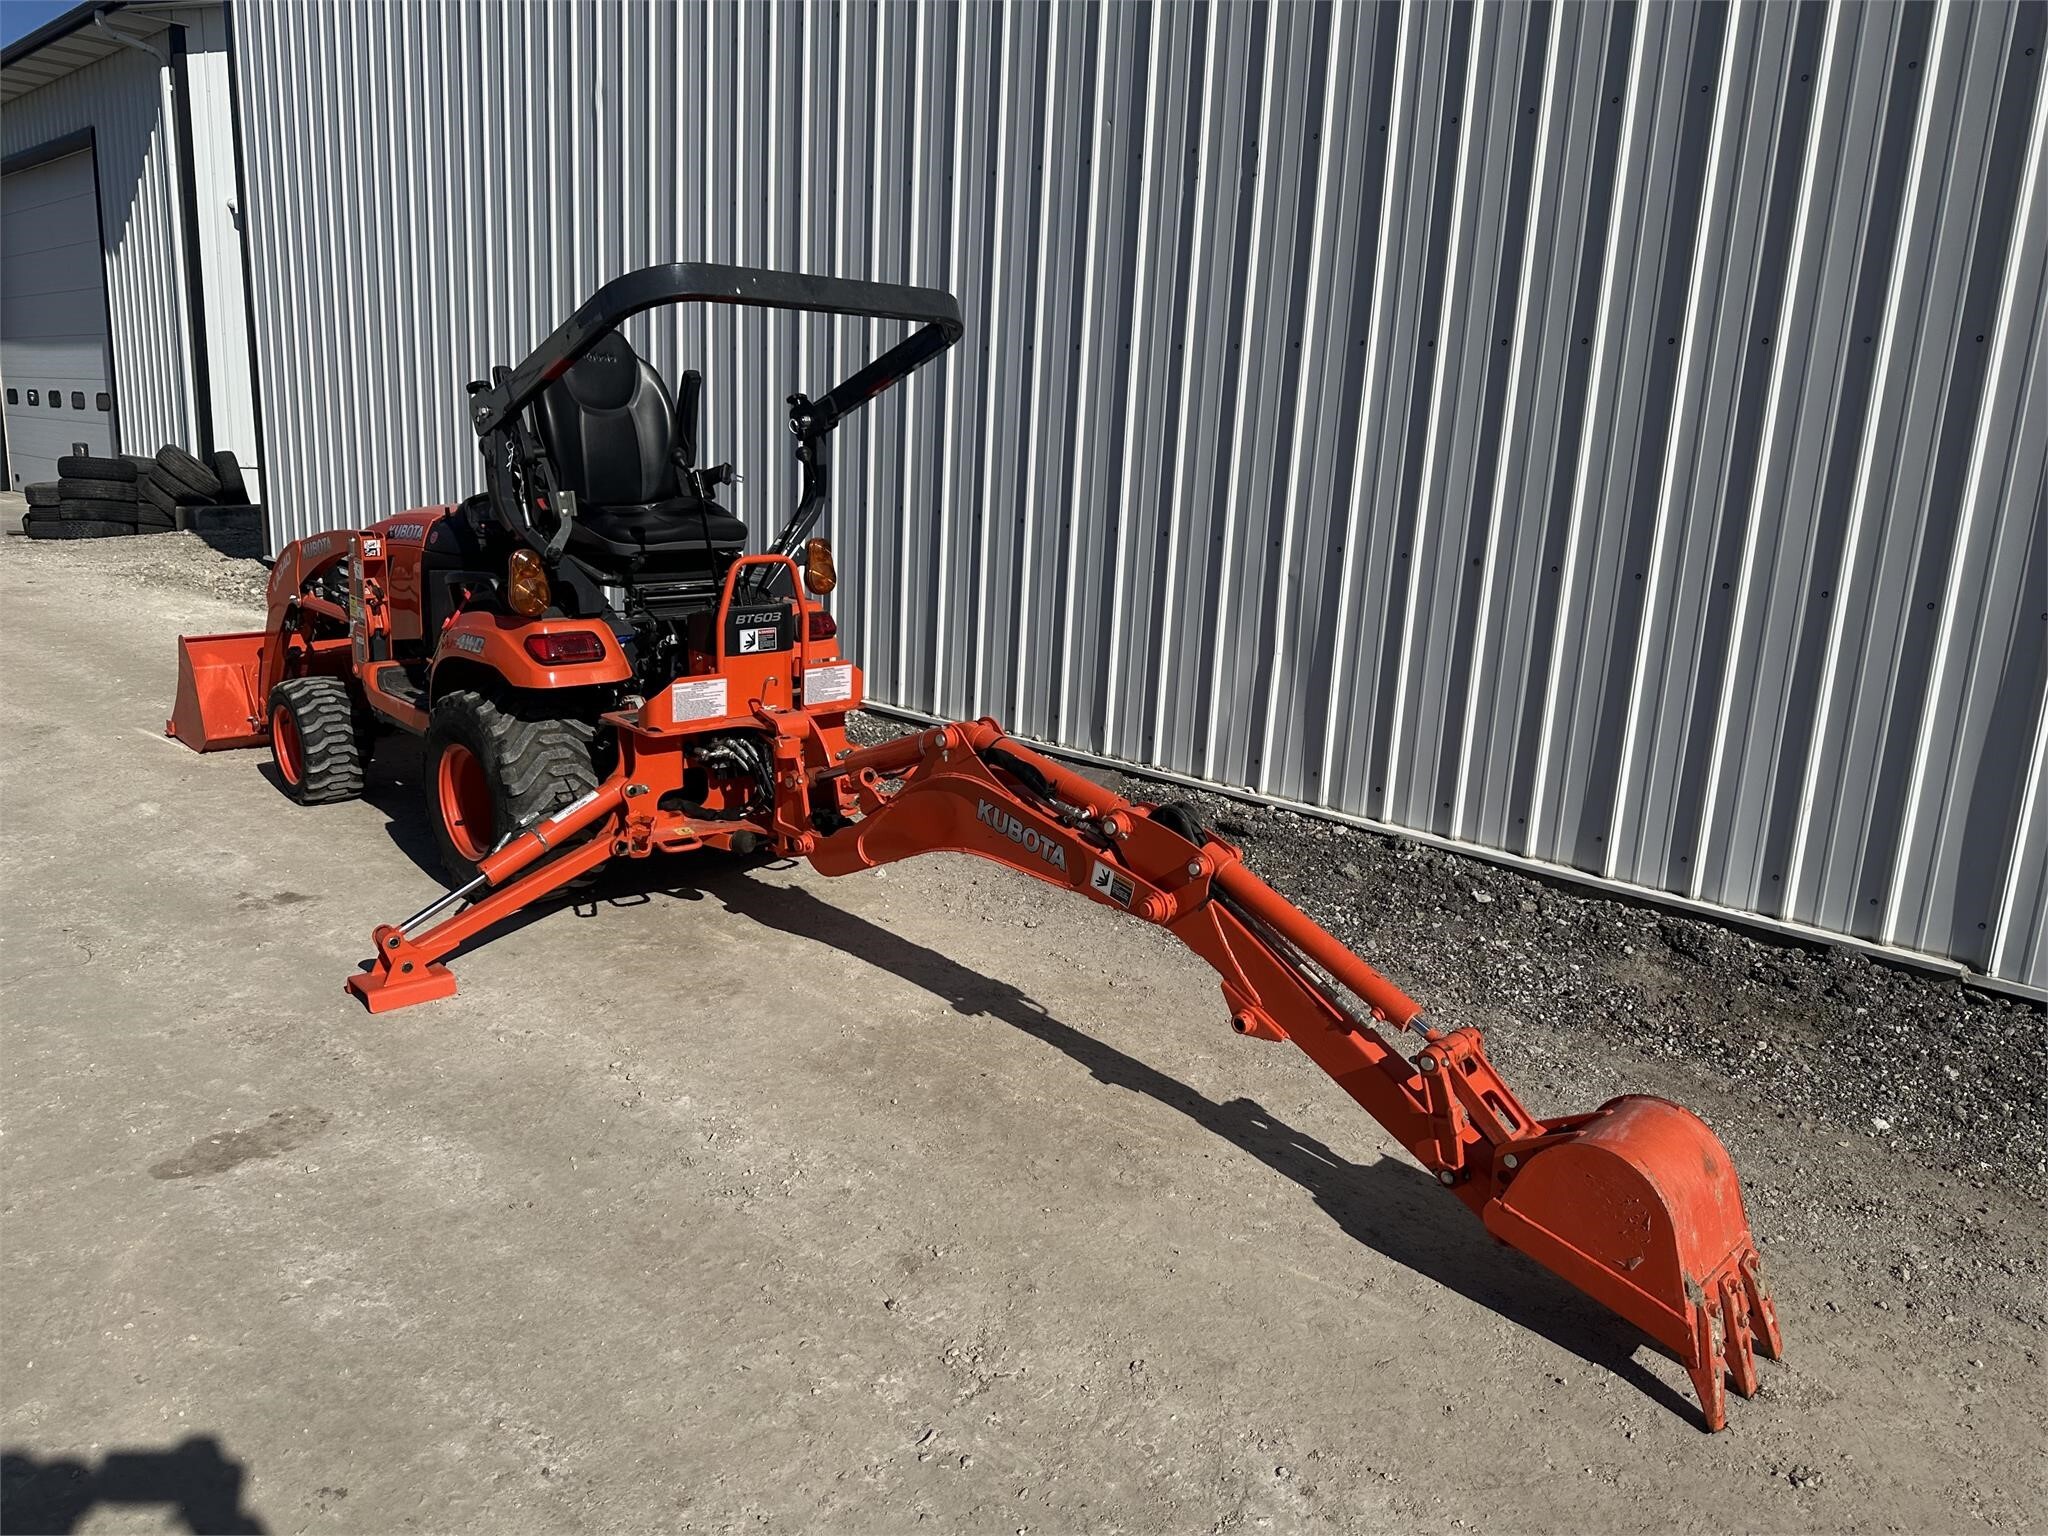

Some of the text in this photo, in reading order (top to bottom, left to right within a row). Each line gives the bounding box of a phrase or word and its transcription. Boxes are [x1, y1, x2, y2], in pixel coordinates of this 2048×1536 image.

[302, 536, 331, 560] KUBOTA
[736, 612, 781, 624] BT603
[455, 633, 486, 653] 4WD
[976, 798, 1067, 872] KUBOTA
